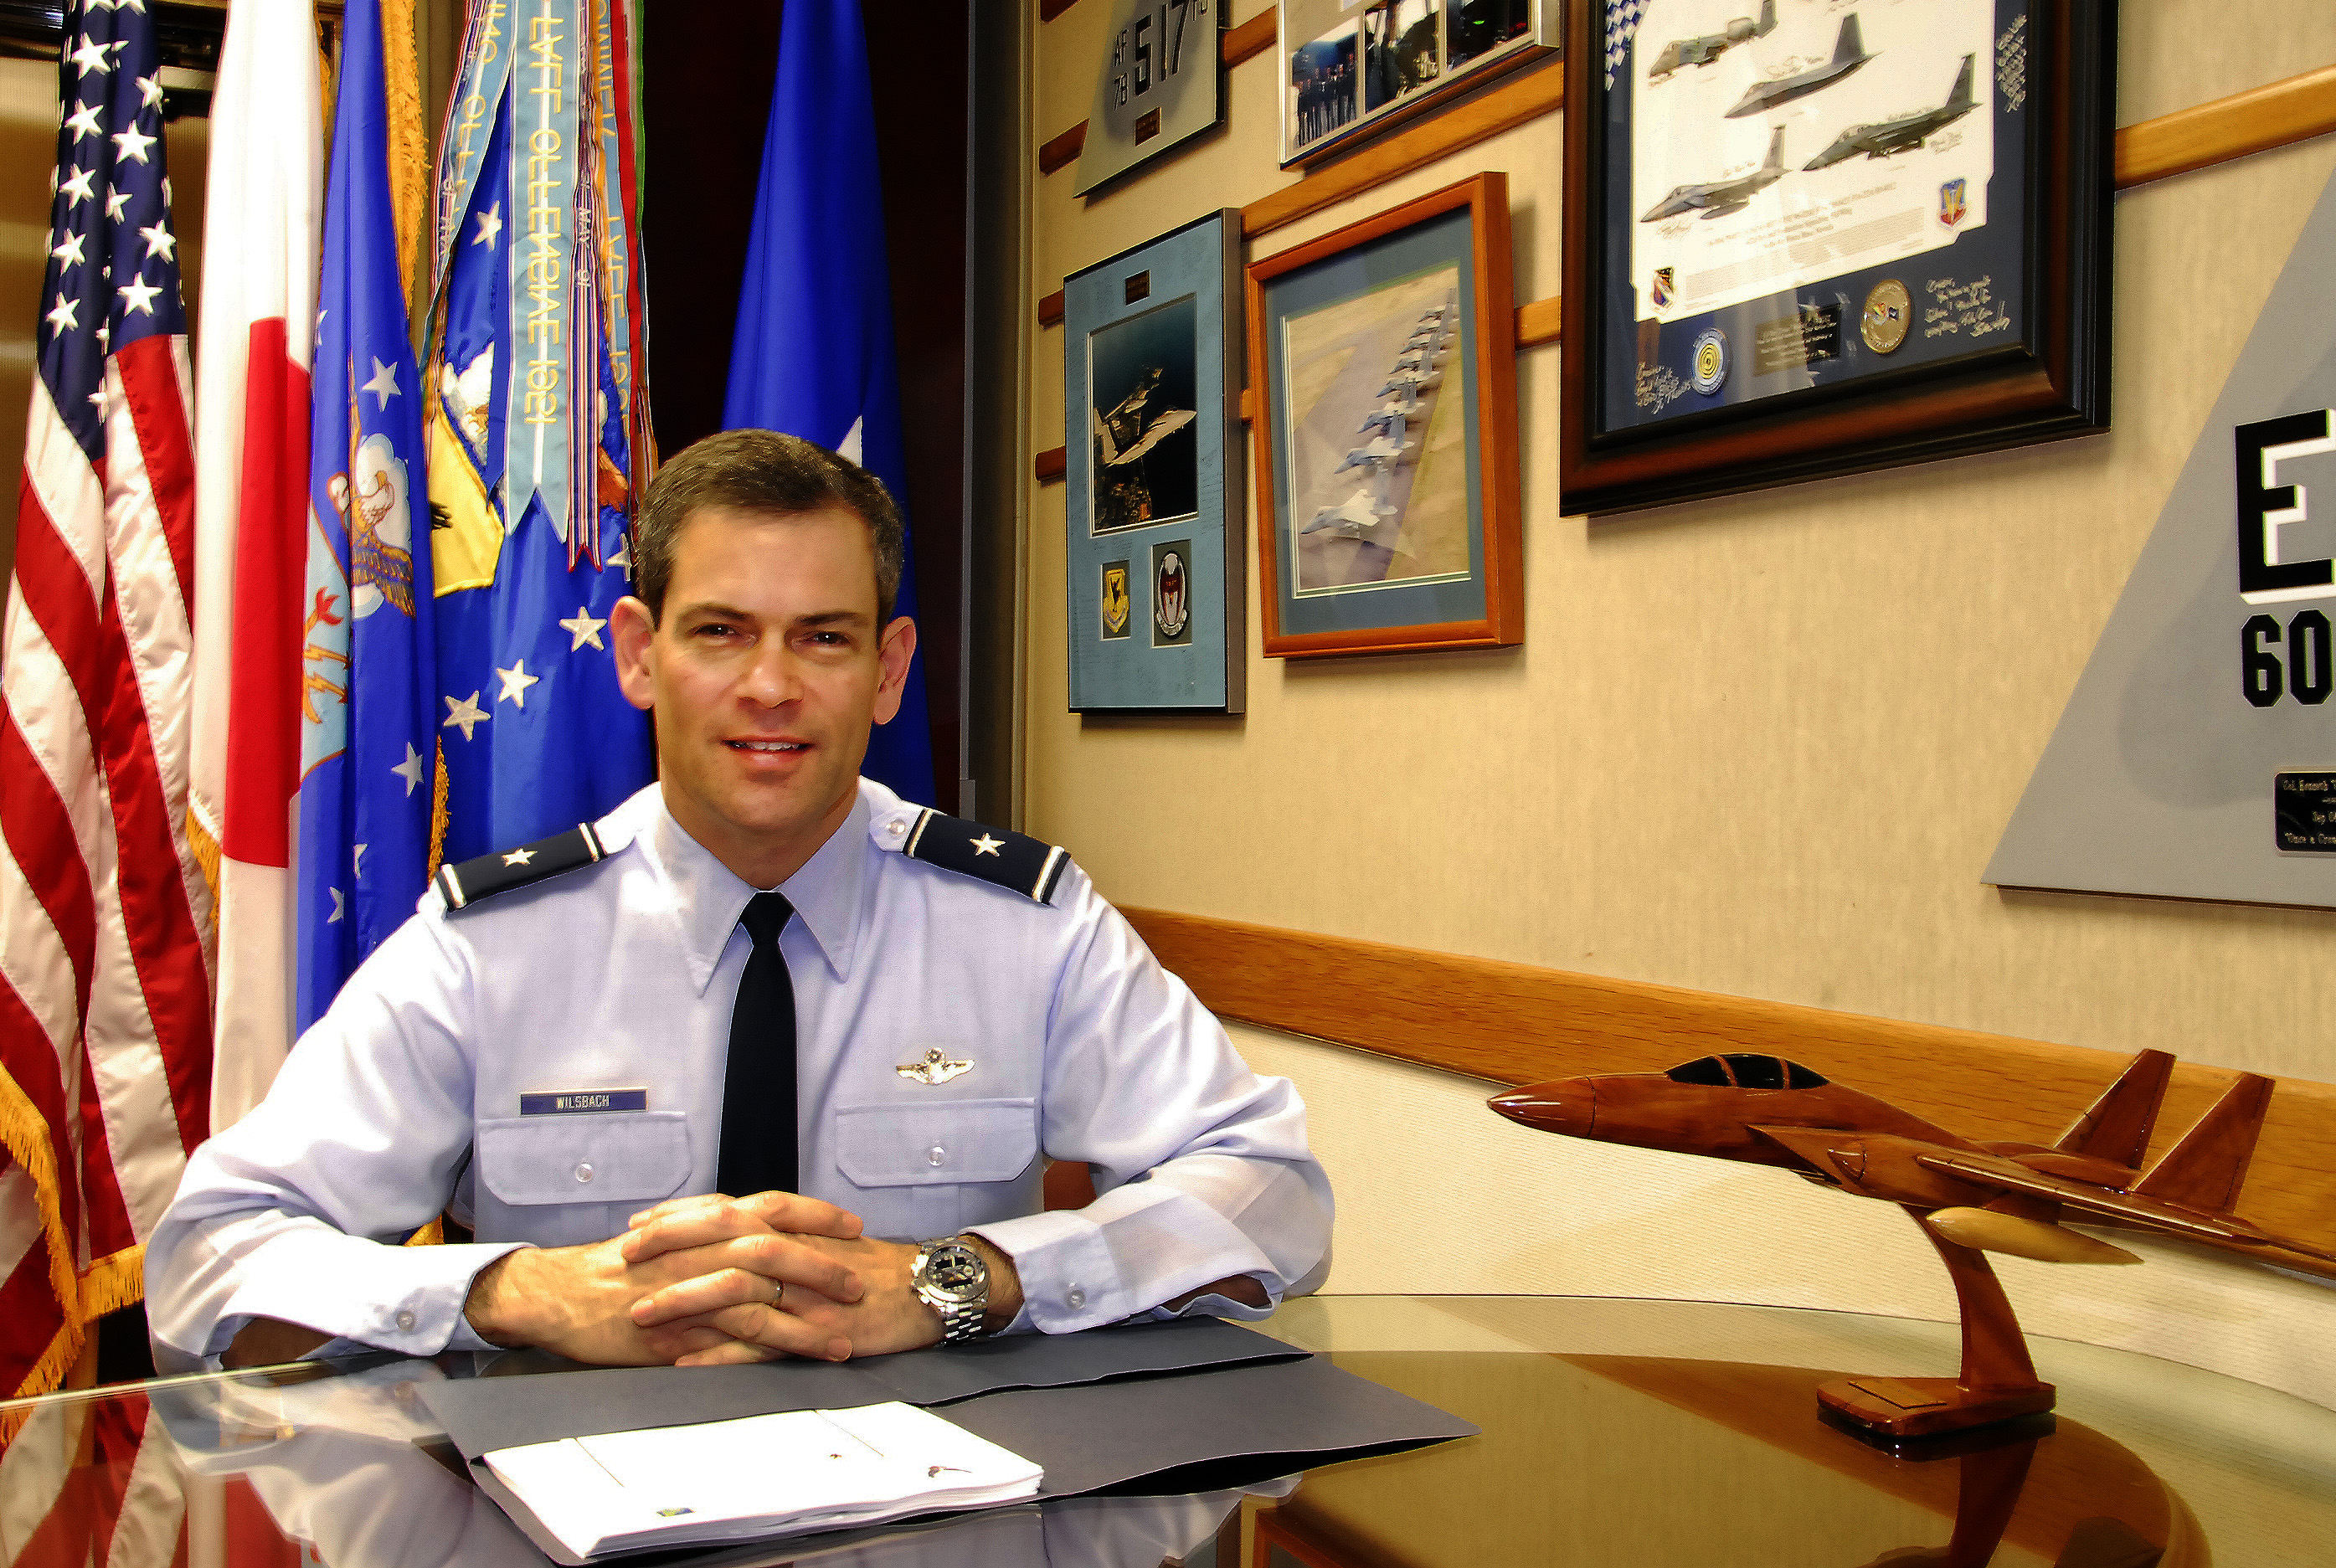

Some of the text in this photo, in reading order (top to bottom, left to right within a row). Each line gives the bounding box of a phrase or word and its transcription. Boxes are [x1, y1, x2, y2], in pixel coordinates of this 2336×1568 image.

[1134, 0, 1189, 99] 517
[2241, 609, 2334, 708] 60
[557, 1095, 610, 1110] WILSBACH
